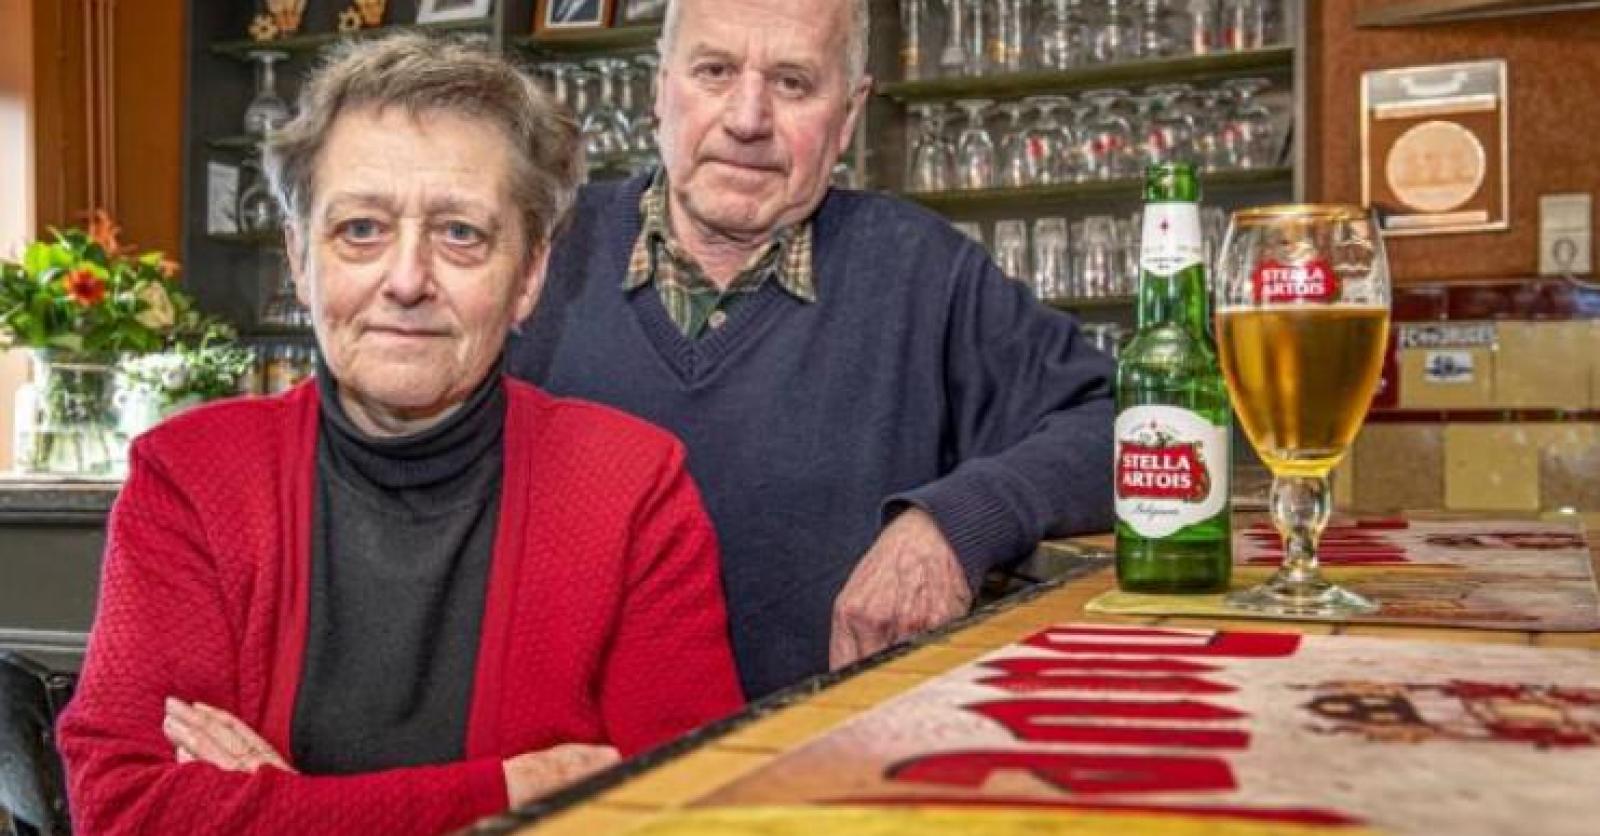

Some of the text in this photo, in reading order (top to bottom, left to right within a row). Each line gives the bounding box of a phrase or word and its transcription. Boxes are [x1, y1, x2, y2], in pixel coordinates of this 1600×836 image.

[1261, 265, 1326, 283] STELLA
[1261, 281, 1326, 298] ARTOIS
[1122, 453, 1192, 470] STELLA
[1122, 470, 1193, 488] ARTOIS
